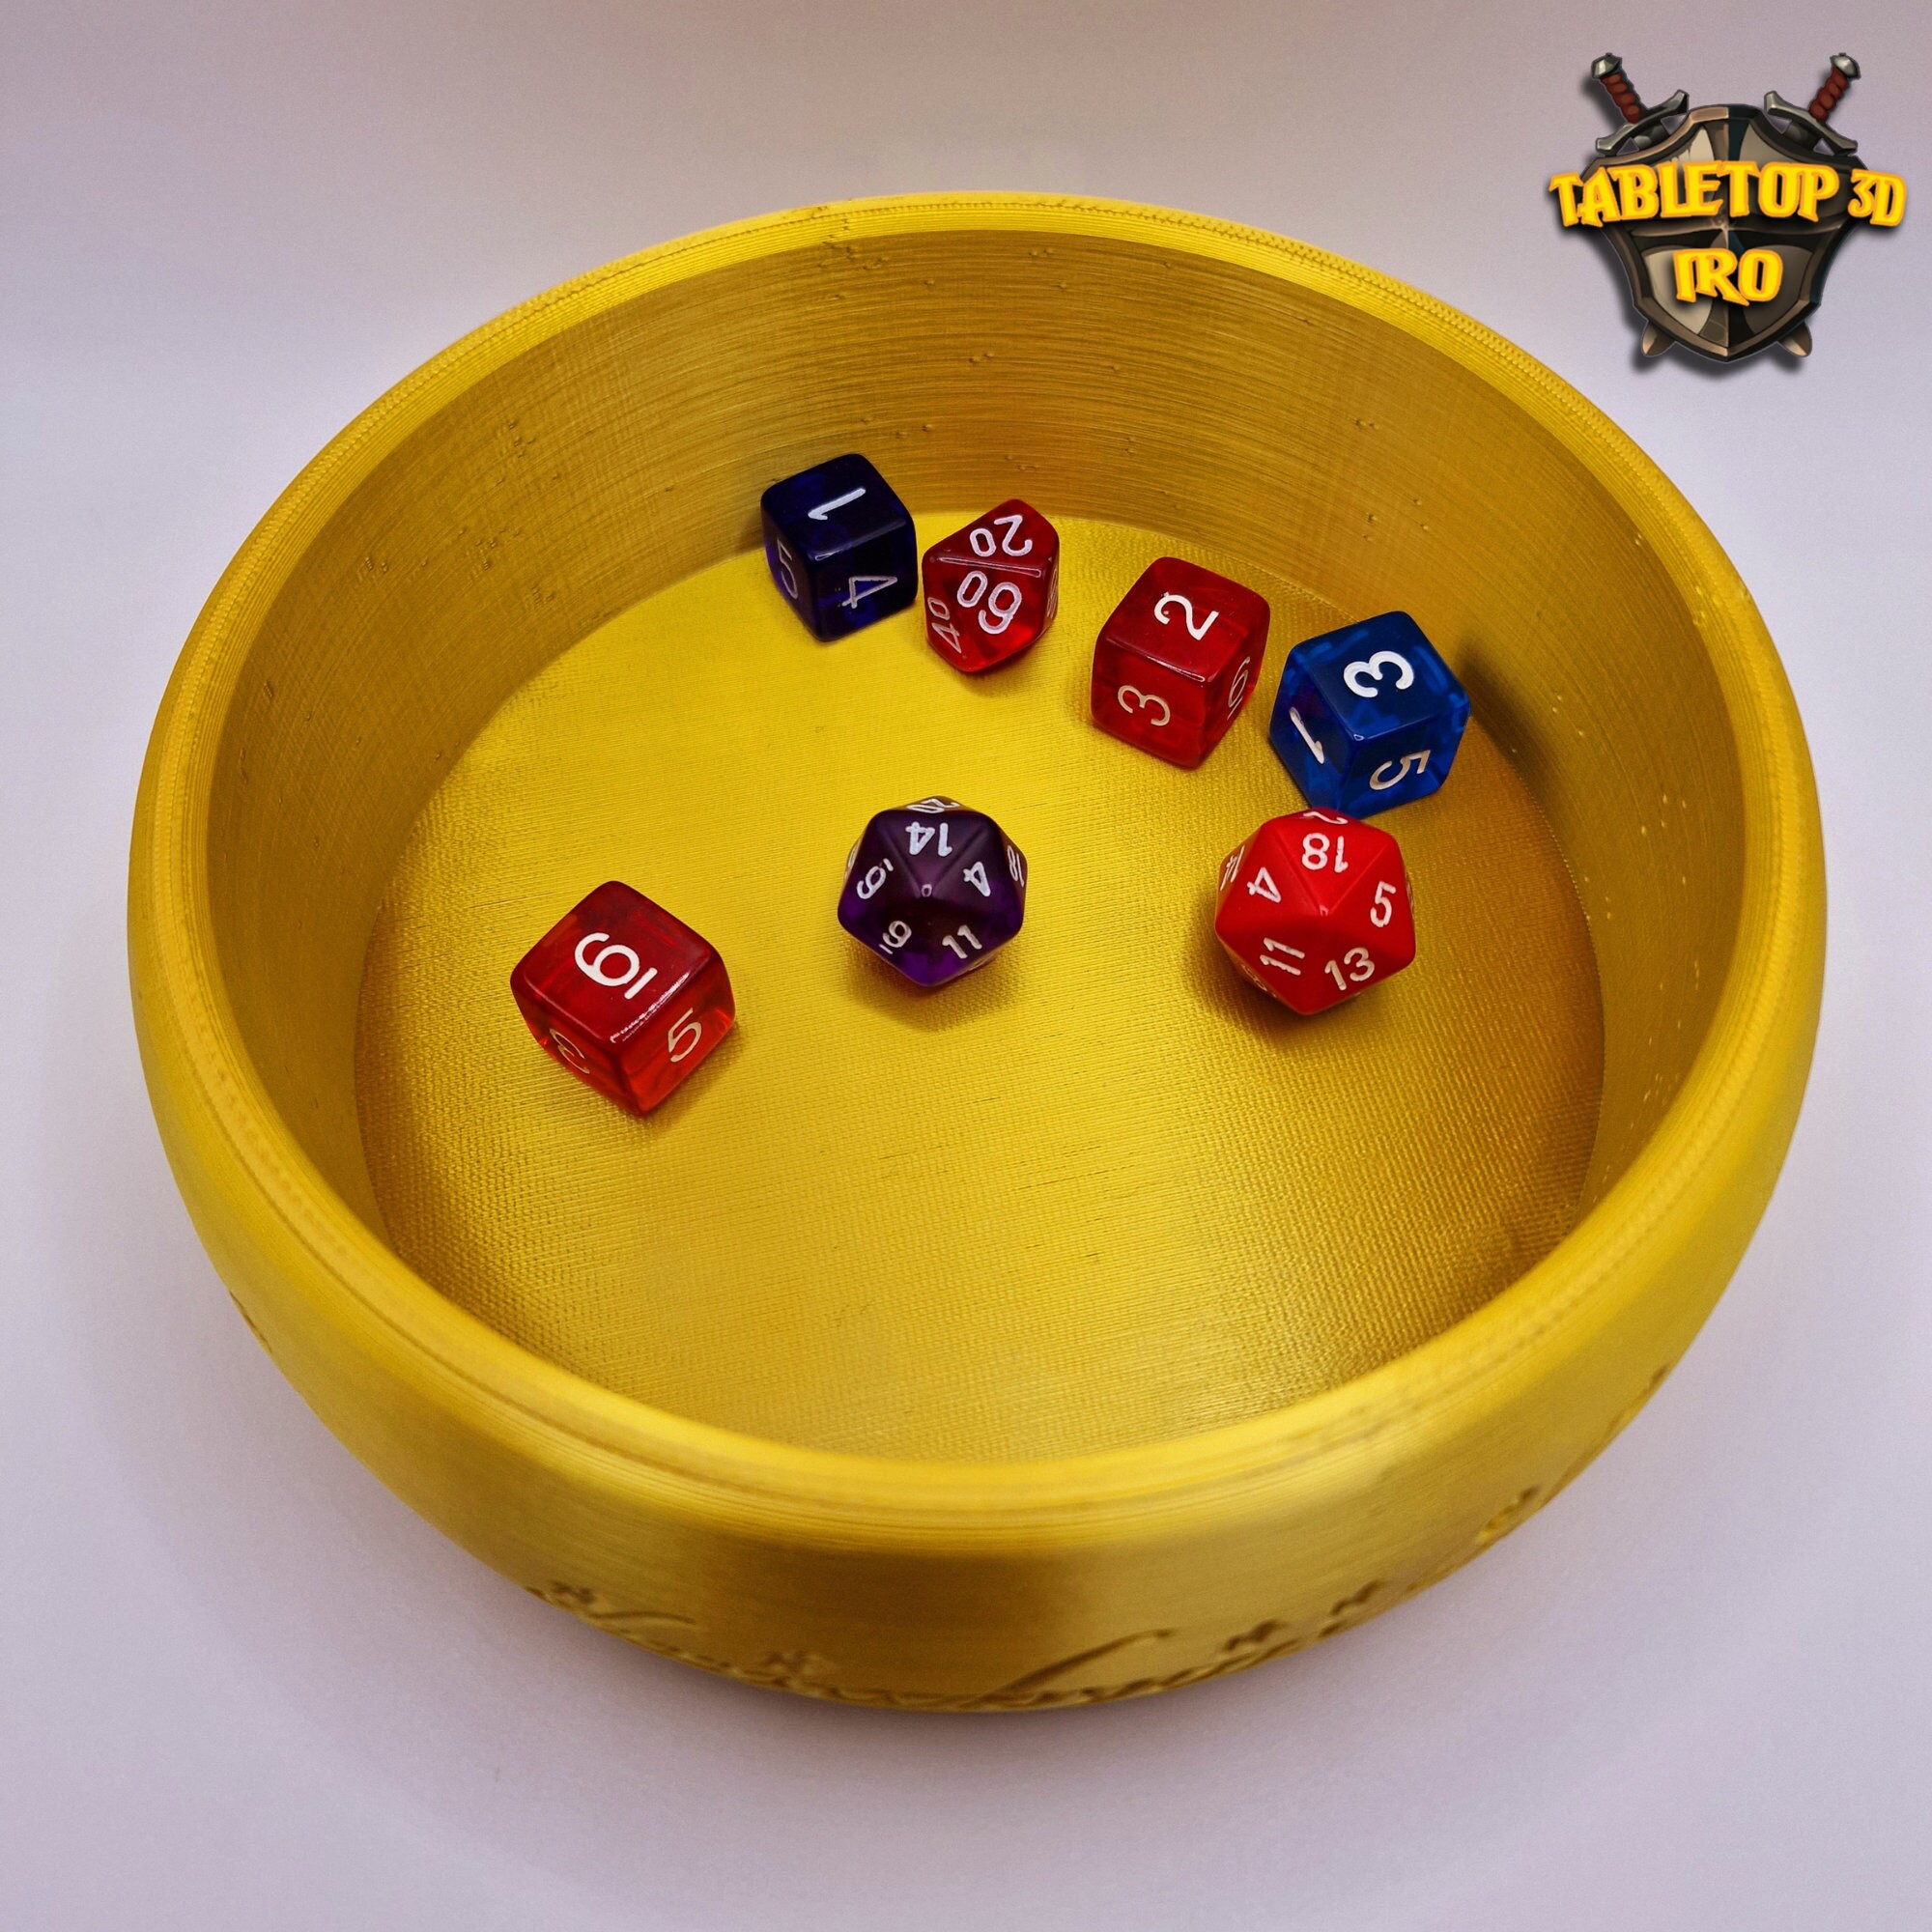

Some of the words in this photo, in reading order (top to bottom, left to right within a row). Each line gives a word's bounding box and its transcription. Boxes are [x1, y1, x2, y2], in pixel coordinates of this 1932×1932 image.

[808, 487, 867, 521] 1
[969, 514, 1034, 557] 20
[776, 538, 799, 599] 5
[841, 576, 898, 609] 4
[927, 596, 962, 654] 40
[1153, 591, 1220, 640] 2
[1342, 650, 1415, 698] 3
[1117, 684, 1171, 727] 3
[1288, 706, 1325, 765] 1
[1369, 750, 1432, 792] 5
[905, 821, 953, 857] 14
[1301, 832, 1350, 873] 18
[963, 861, 991, 897] 4
[1247, 867, 1282, 903] 4
[1370, 880, 1397, 927] 5
[942, 924, 983, 959] 11
[1259, 937, 1306, 977] 11
[1324, 947, 1376, 991] 13
[668, 1008, 703, 1064] 5
